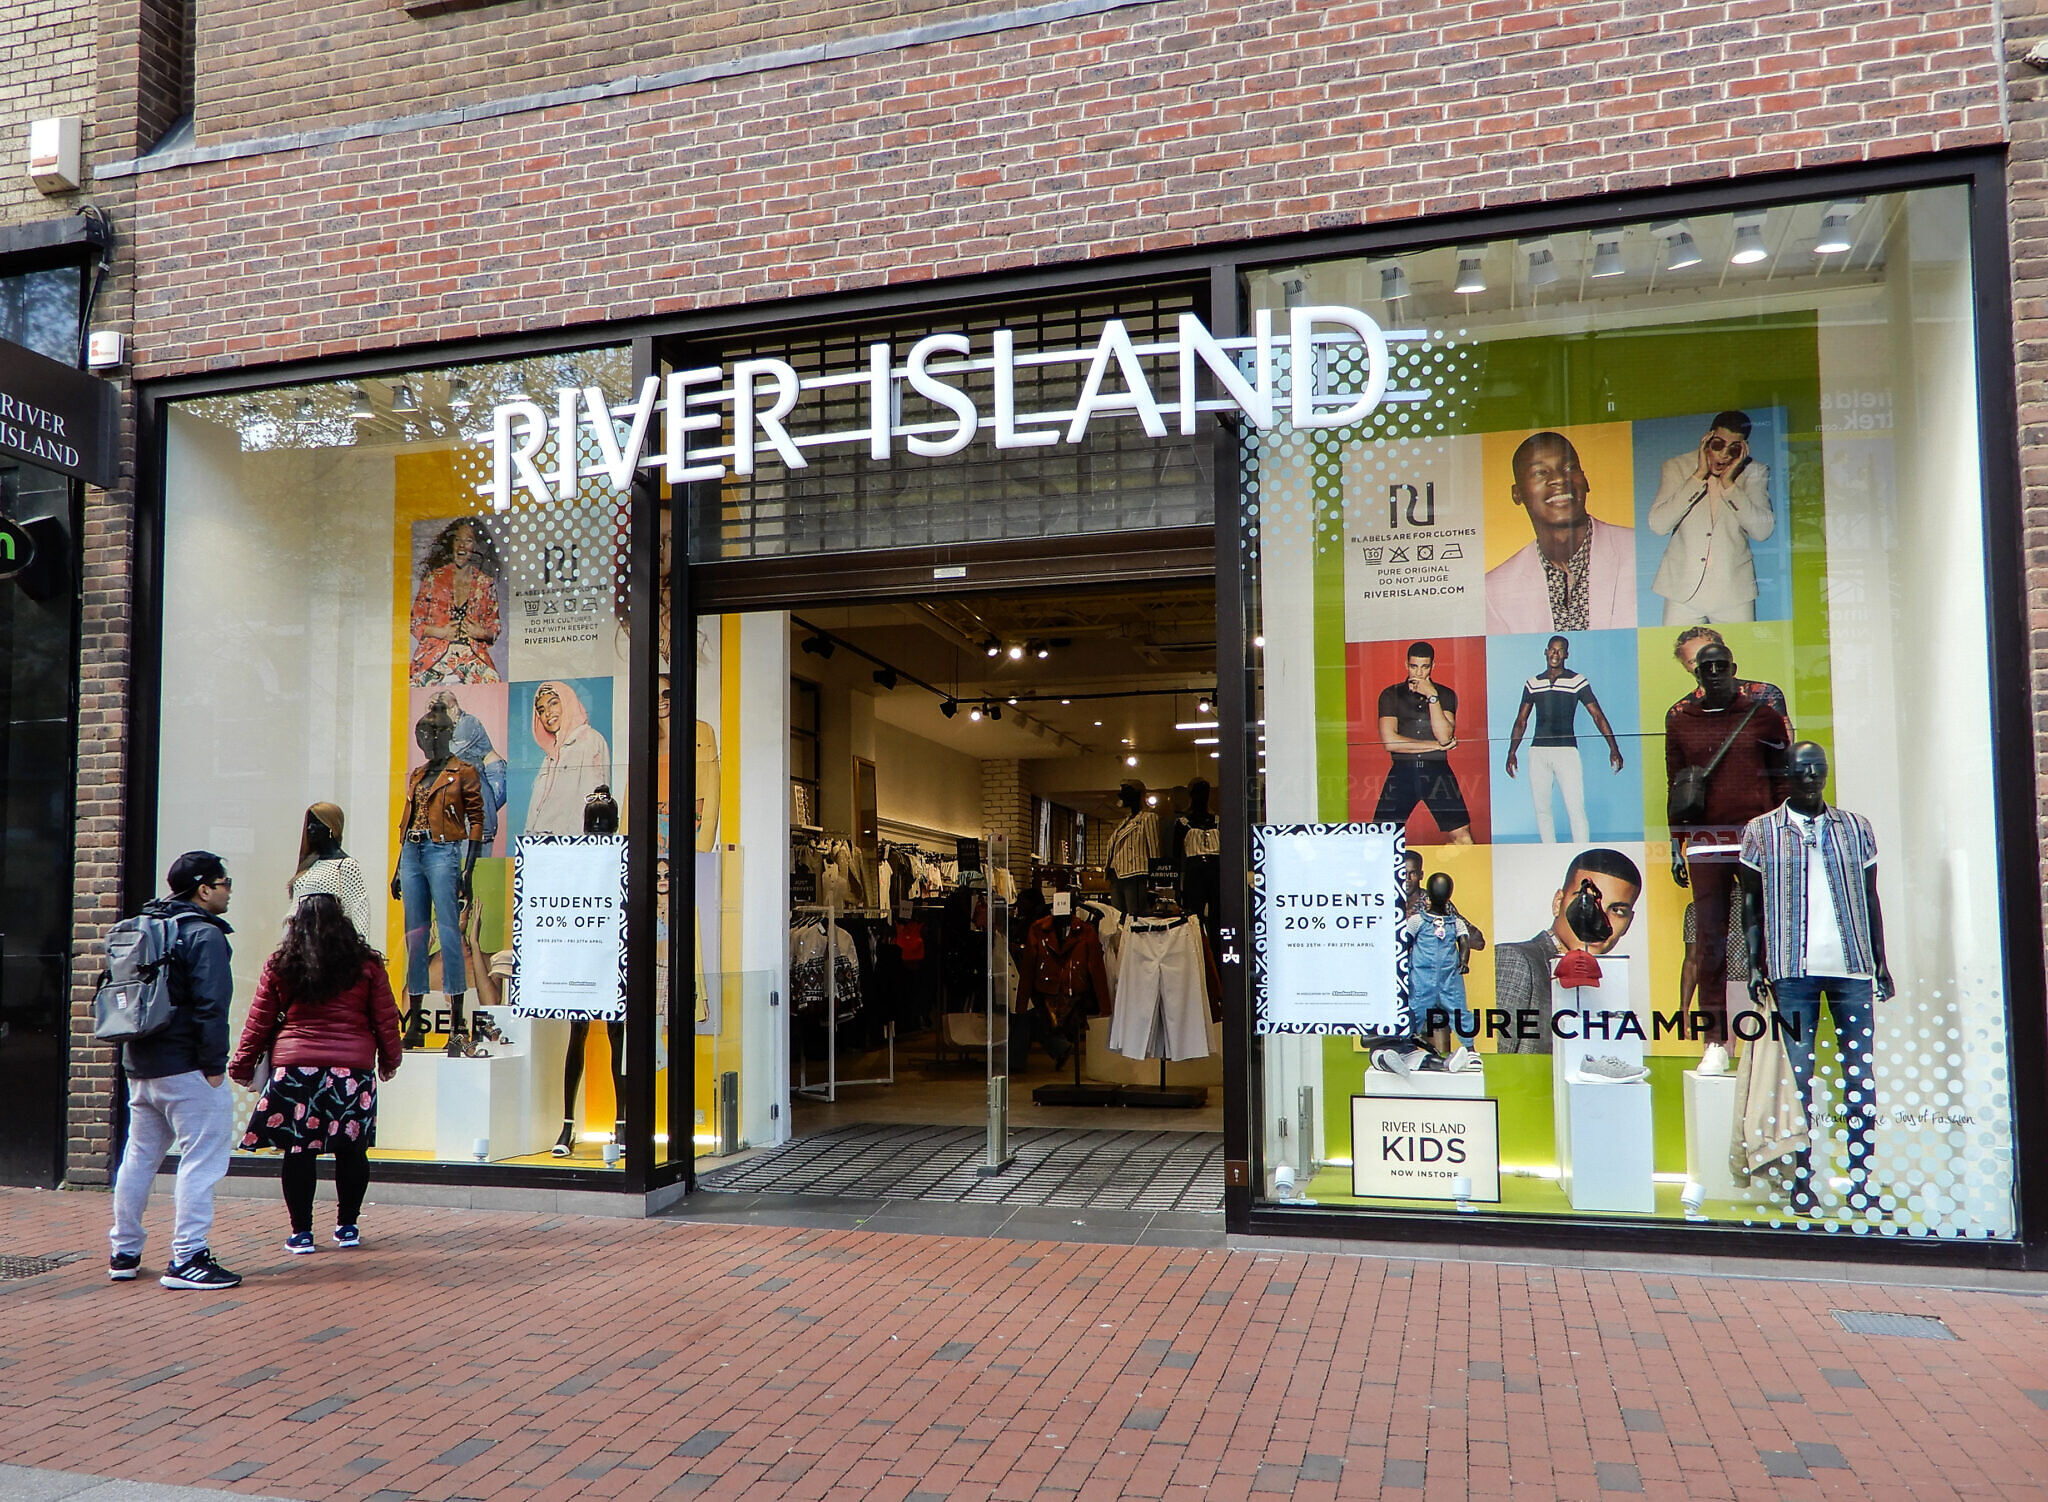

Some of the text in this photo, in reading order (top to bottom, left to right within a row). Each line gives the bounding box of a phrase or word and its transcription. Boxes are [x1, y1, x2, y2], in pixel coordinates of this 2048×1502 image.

[0, 392, 66, 437] RIVER
[492, 305, 1389, 511] RIVER ISLAND
[0, 421, 80, 467] ISLAND
[1377, 565, 1450, 576] PURE ORIGINAL
[1379, 575, 1449, 586] DO NOT JUDGE
[1364, 586, 1465, 599] RIVERISLAND.COM
[543, 617, 555, 625] MIX
[525, 623, 599, 634] TREAT WITH RESPECT
[524, 634, 599, 645] RIVERISLAND.COM
[530, 896, 613, 909] STUDENTS
[1276, 893, 1385, 908] STUDENTS
[536, 916, 568, 928] 20%
[1285, 916, 1326, 930] 20%
[1426, 1008, 1801, 1042] PURE CHAMPION
[1895, 1110, 1916, 1126] Joy
[1382, 1121, 1466, 1135] RIVER ISLAND
[1382, 1135, 1467, 1164] KIDS
[1391, 1169, 1414, 1177] NOW
